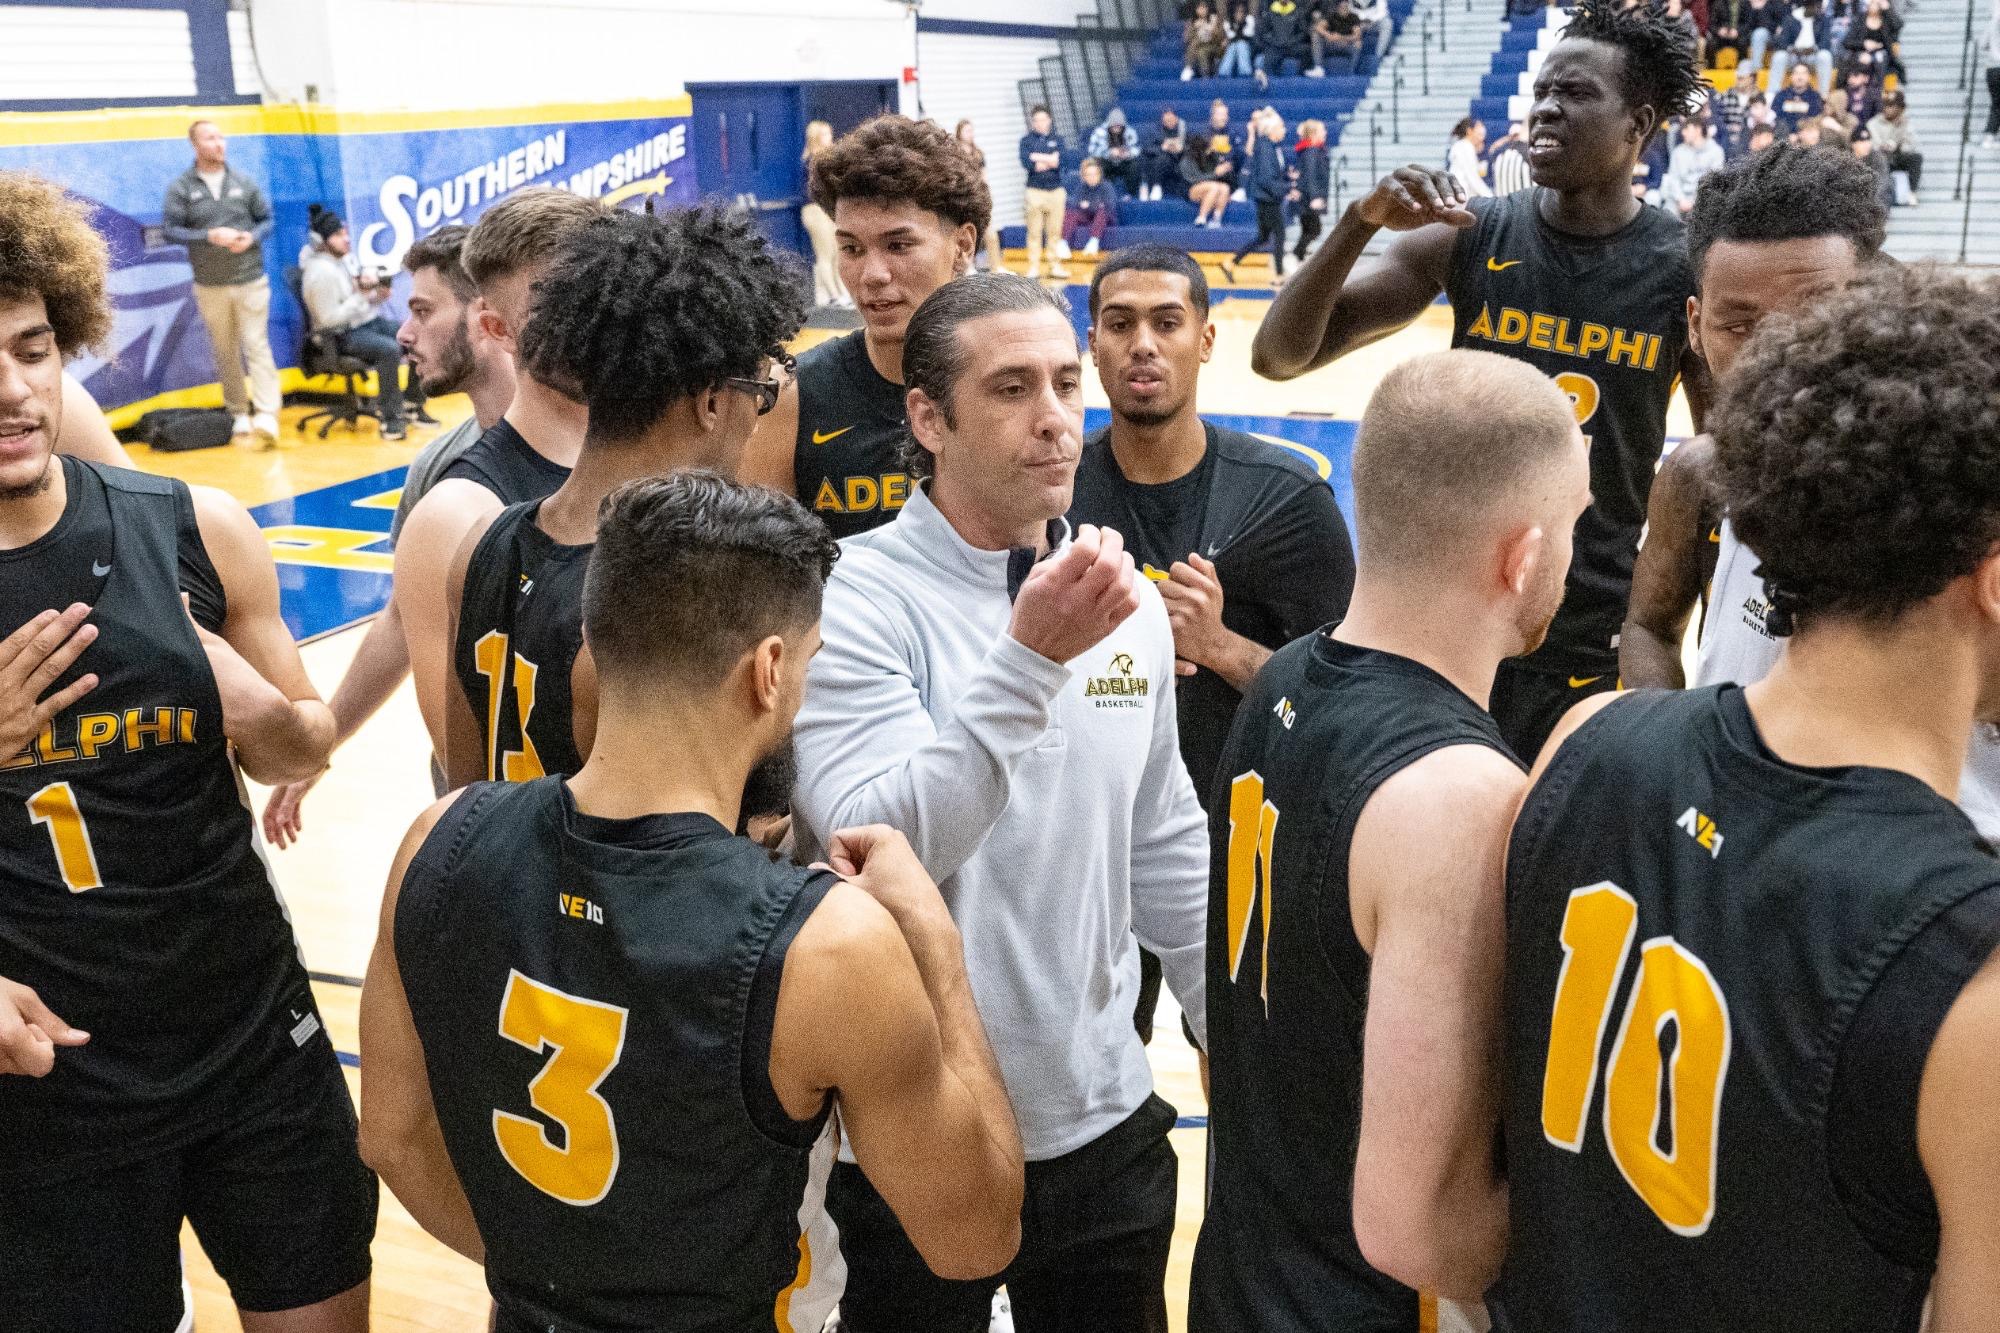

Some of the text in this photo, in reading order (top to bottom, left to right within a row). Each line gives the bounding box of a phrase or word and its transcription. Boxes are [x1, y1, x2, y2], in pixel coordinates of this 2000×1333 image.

[538, 124, 686, 200] MPSHIRE
[1467, 300, 1663, 372] ADELPHI
[474, 627, 547, 783] 13
[24, 781, 105, 894] 1
[492, 968, 629, 1207] 3
[1542, 880, 1731, 1237] 10
